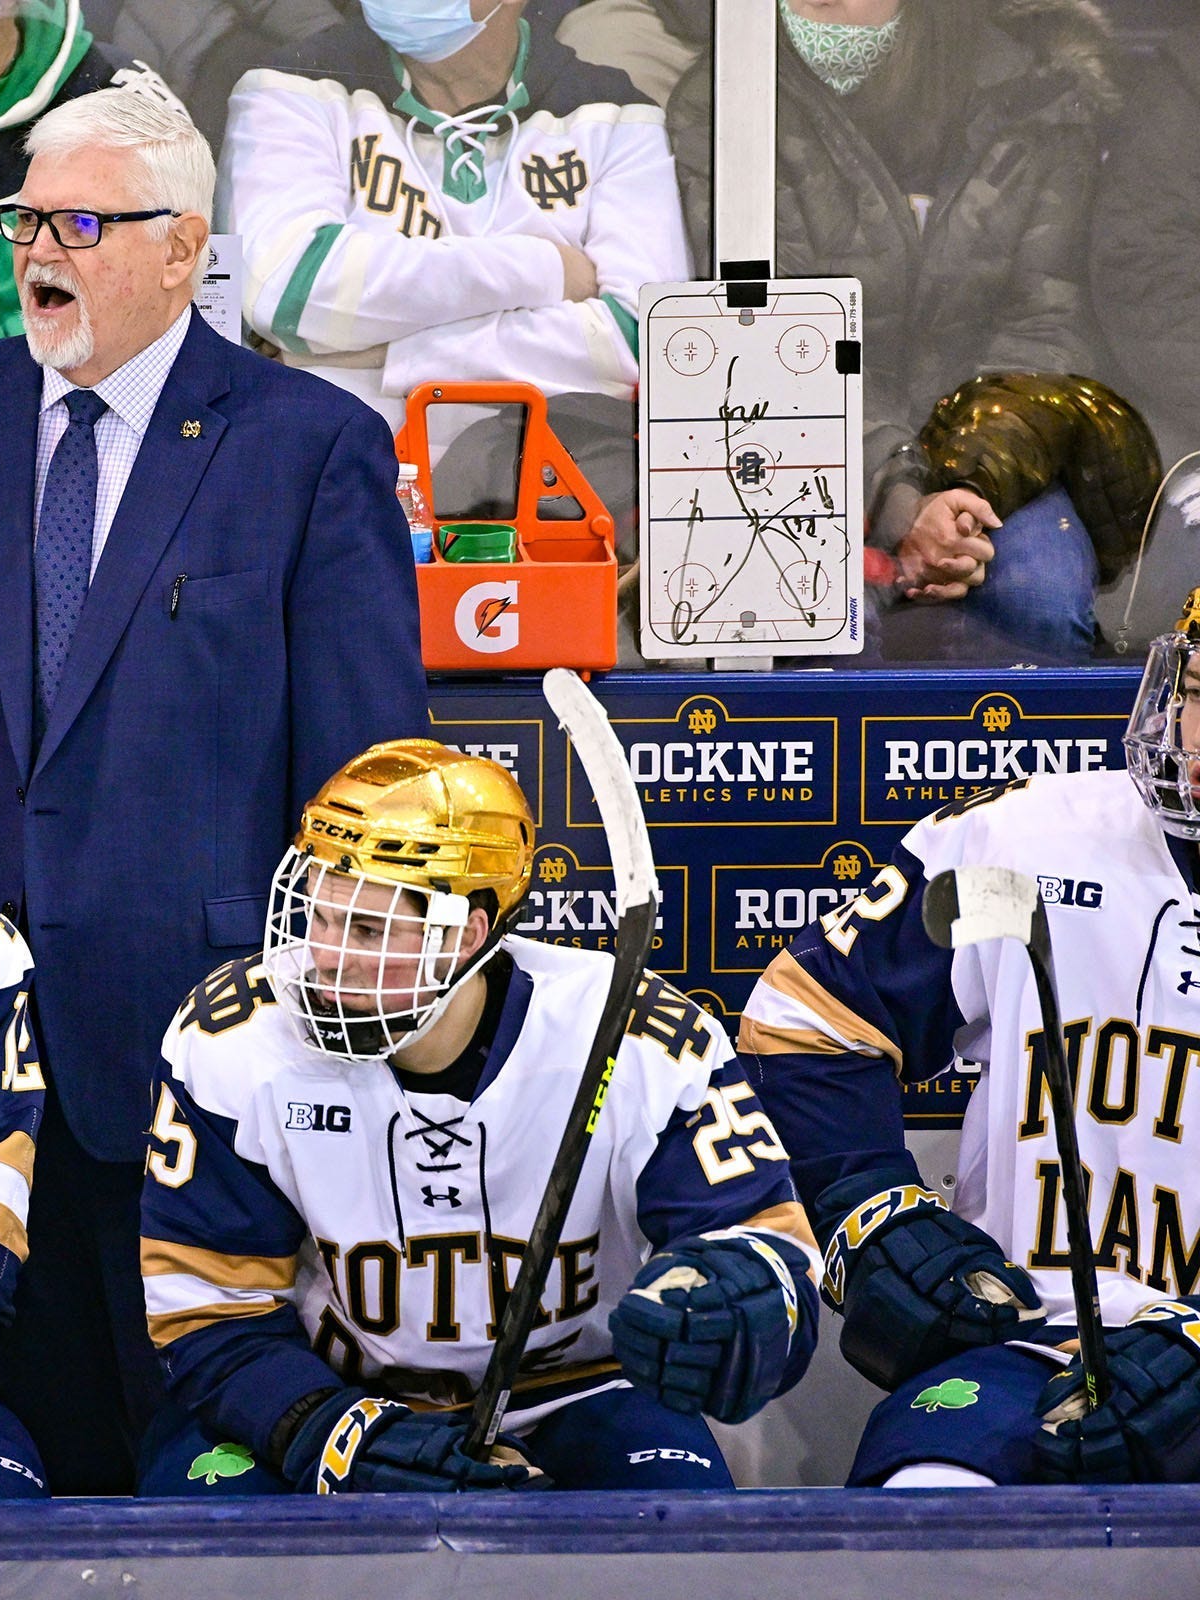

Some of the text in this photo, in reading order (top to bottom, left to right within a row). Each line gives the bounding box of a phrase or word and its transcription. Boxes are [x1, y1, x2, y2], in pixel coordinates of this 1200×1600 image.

[351, 133, 443, 240] NOTR
[454, 580, 520, 653] G
[849, 596, 858, 641] PAKMARK
[630, 742, 813, 782] OCKNE
[885, 739, 1107, 781] ROCKNE
[645, 788, 813, 803] LETICS FUND
[886, 787, 984, 801] ATHLET
[312, 818, 363, 843] CCM
[148, 1080, 198, 1189] 5
[685, 1080, 791, 1186] 25
[822, 1184, 950, 1306] CCM
[626, 1447, 711, 1469] CCM
